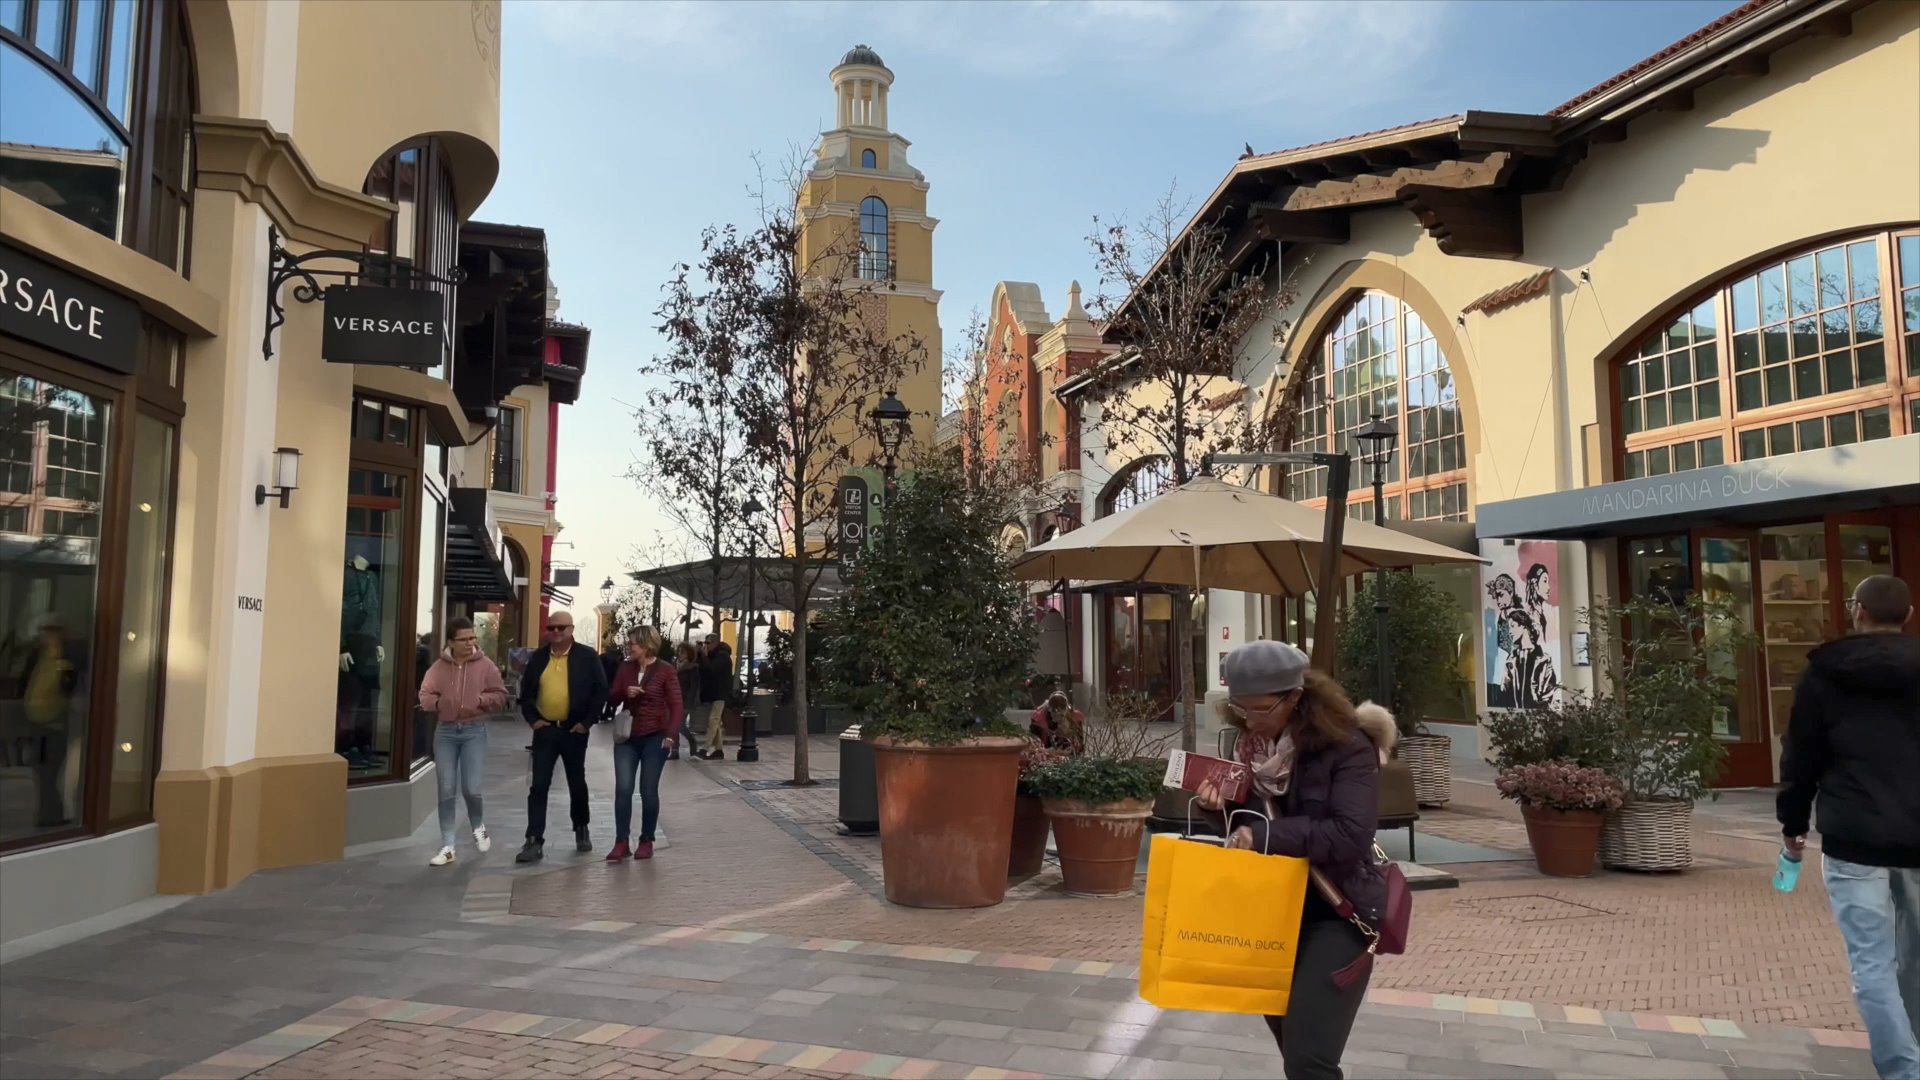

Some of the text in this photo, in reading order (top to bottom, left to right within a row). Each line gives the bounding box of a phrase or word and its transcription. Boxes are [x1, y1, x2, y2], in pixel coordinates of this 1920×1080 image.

[333, 316, 434, 335] VERSACE
[1582, 466, 1791, 516] MANDARINA DUCK
[238, 596, 262, 612] VERSACE
[1177, 929, 1286, 951] MANDARINA DUCK
